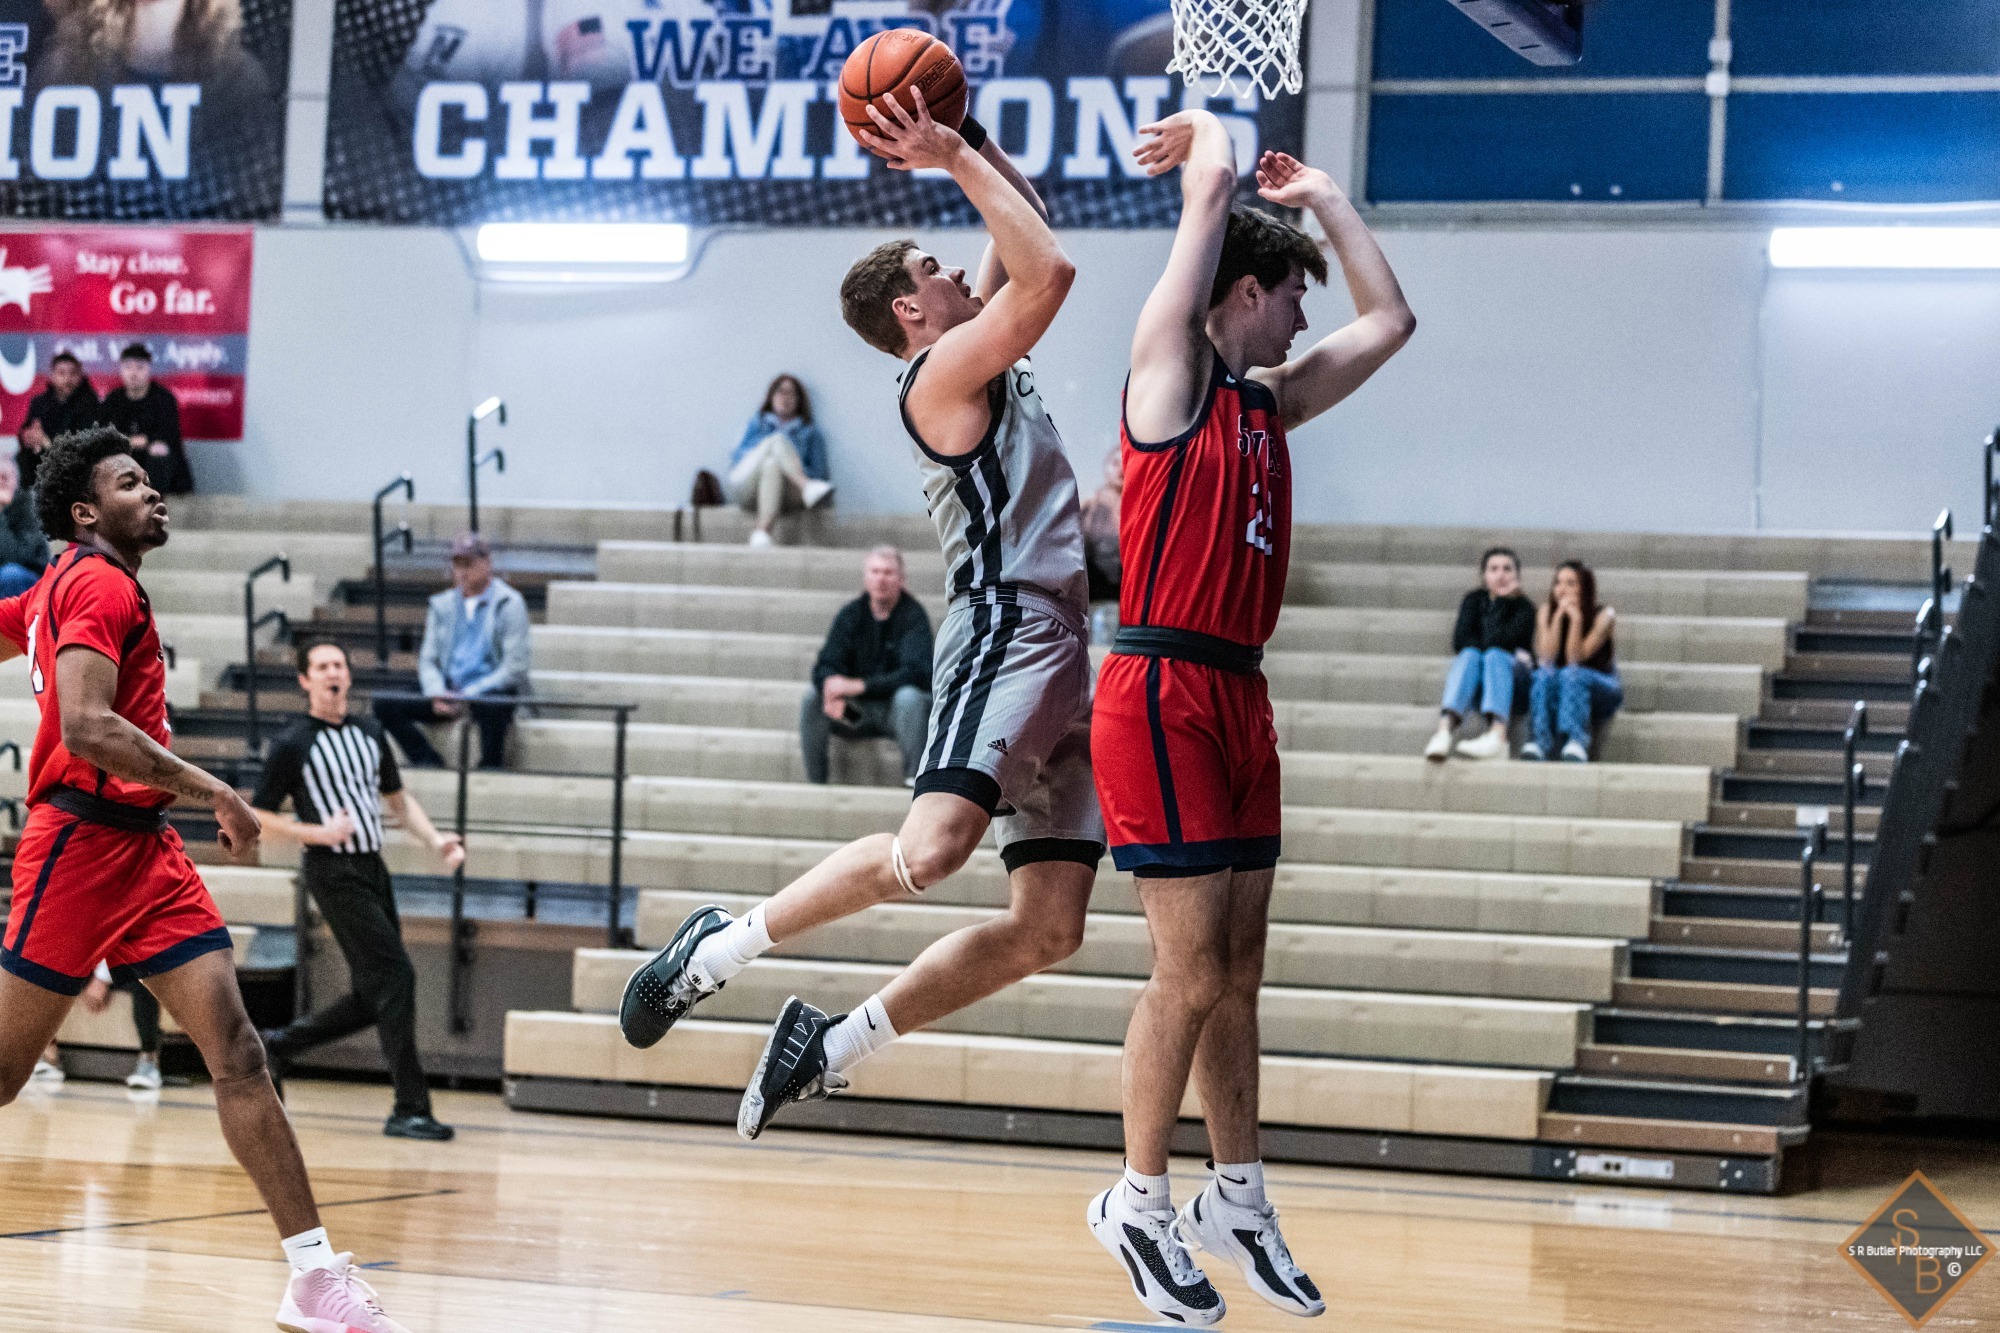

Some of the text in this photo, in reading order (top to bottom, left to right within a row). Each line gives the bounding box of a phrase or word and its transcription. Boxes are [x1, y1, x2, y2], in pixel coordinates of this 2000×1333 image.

[624, 15, 1006, 87] WE AE
[413, 77, 1259, 180] CHAMONS
[76, 251, 123, 279] Stay
[110, 280, 215, 315] Go far.
